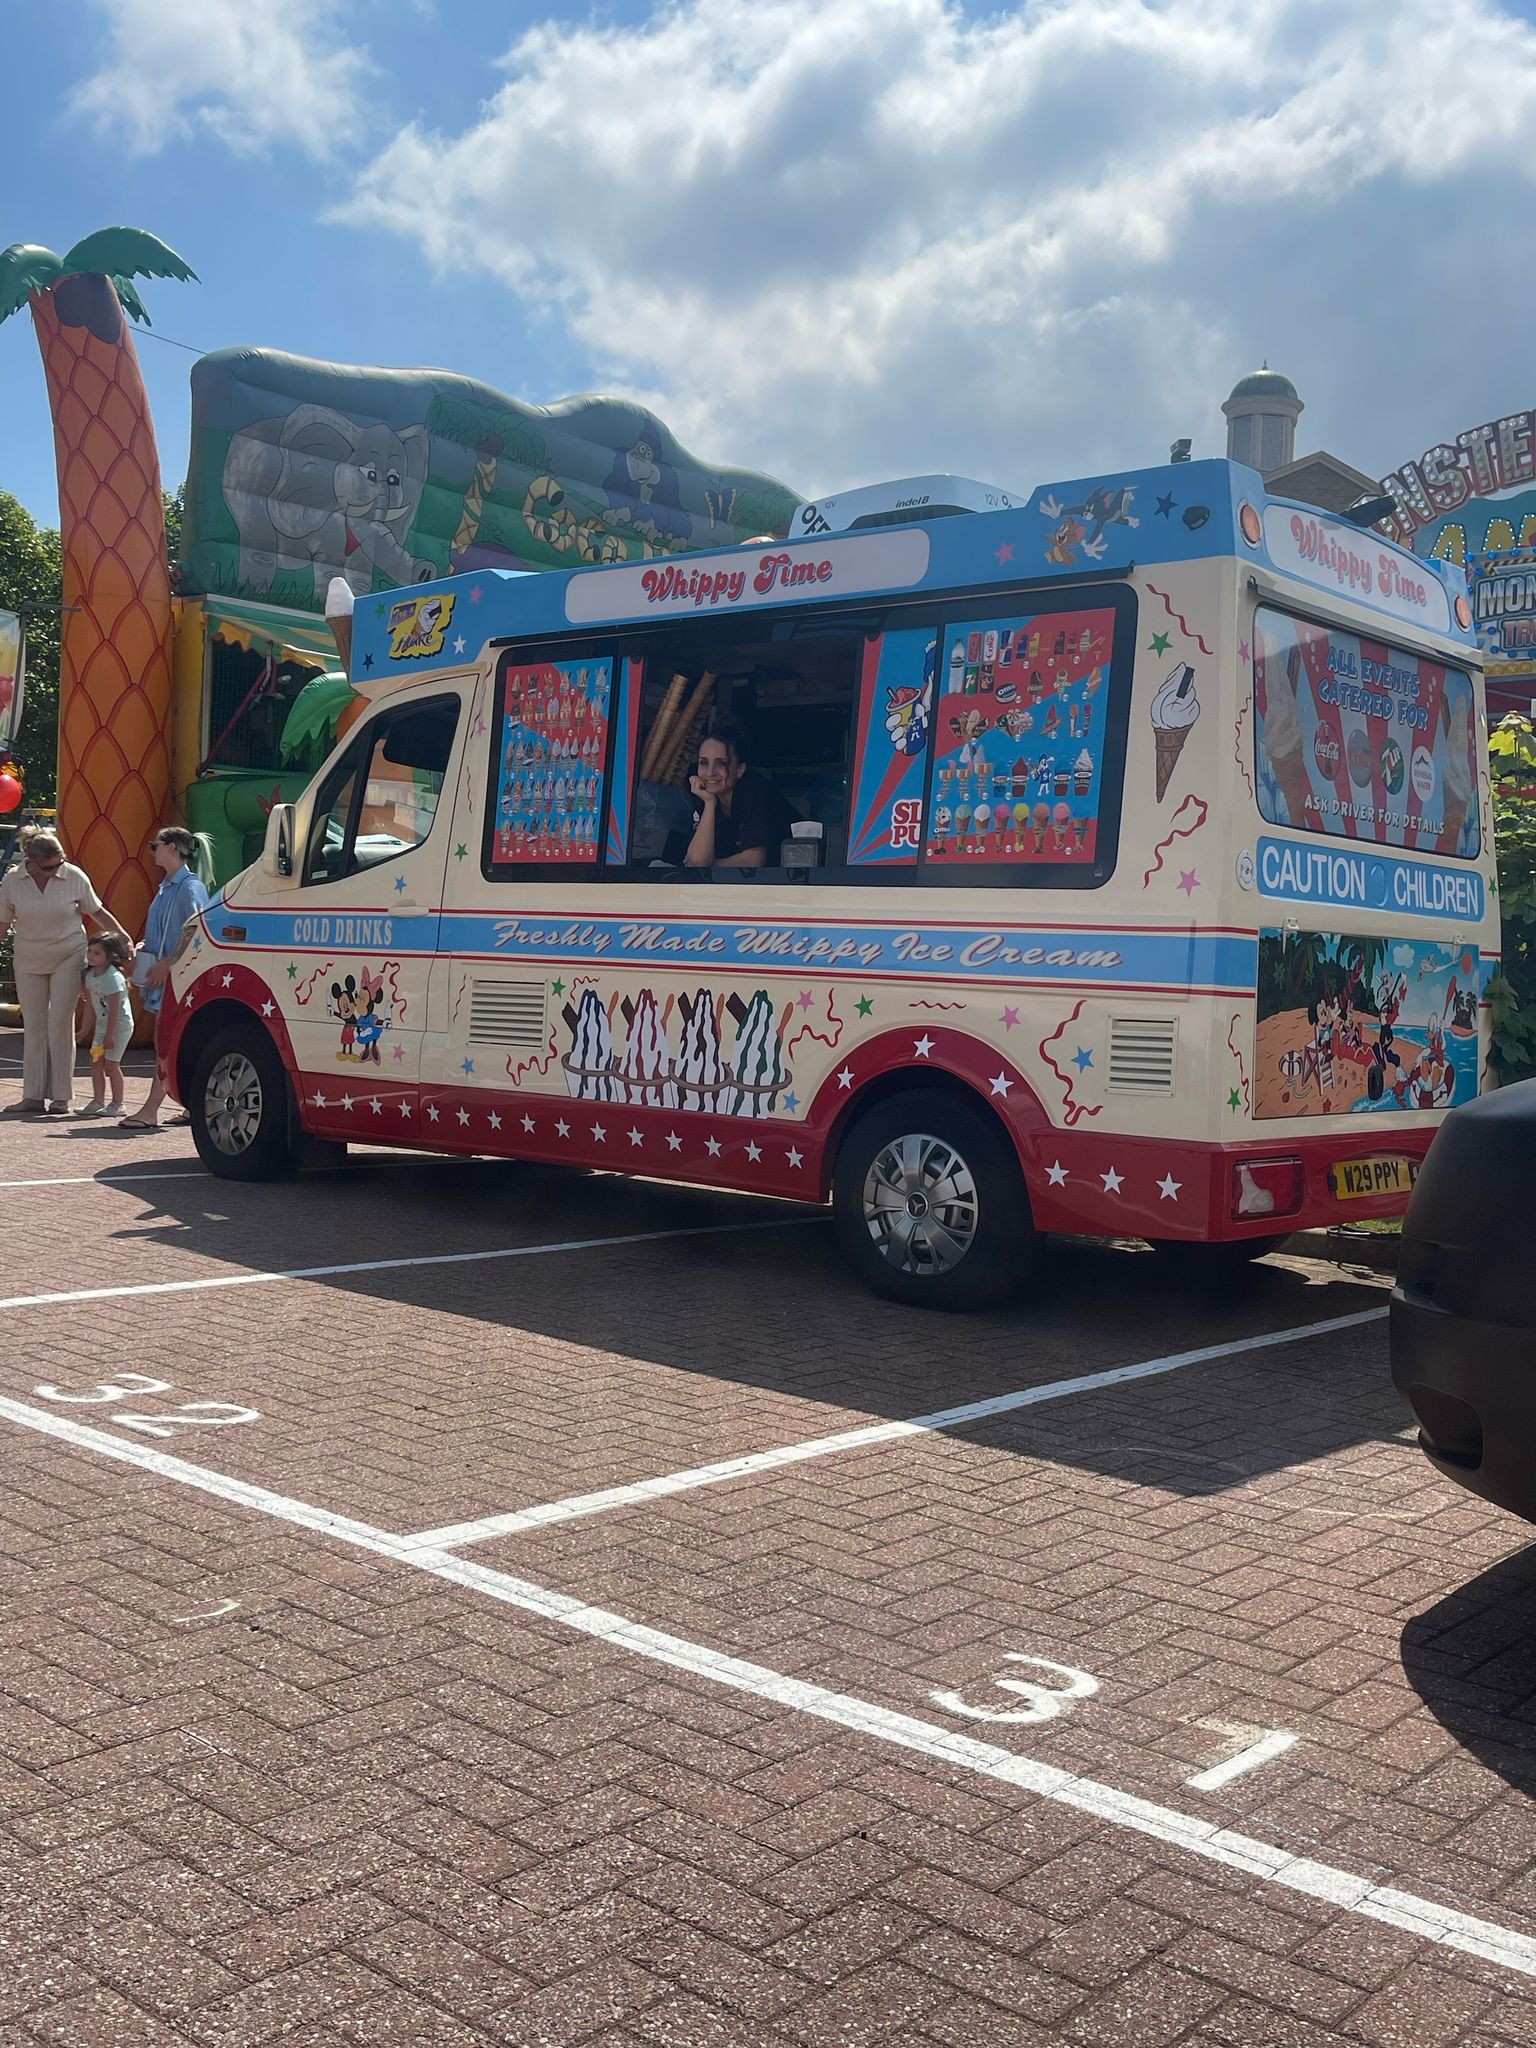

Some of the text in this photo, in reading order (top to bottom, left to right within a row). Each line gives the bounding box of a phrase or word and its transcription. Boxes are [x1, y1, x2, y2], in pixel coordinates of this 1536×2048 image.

[1350, 414, 1536, 542] NSTE
[641, 553, 833, 606] Whippy Time
[1289, 514, 1372, 594] Whippy
[1377, 553, 1426, 607] Time
[1501, 621, 1536, 647] TR
[1326, 646, 1421, 698] ALL EVENTS
[1318, 677, 1429, 732] CATERED FOR
[1304, 793, 1445, 836] ASK DRIVER FOR DETAILS
[1262, 845, 1479, 916] CAUTION CHILDREN
[293, 917, 393, 946] COLD DRINKS
[492, 920, 1124, 969] Freshly Made Whippy Ice Cream
[1374, 1160, 1400, 1190] PPY
